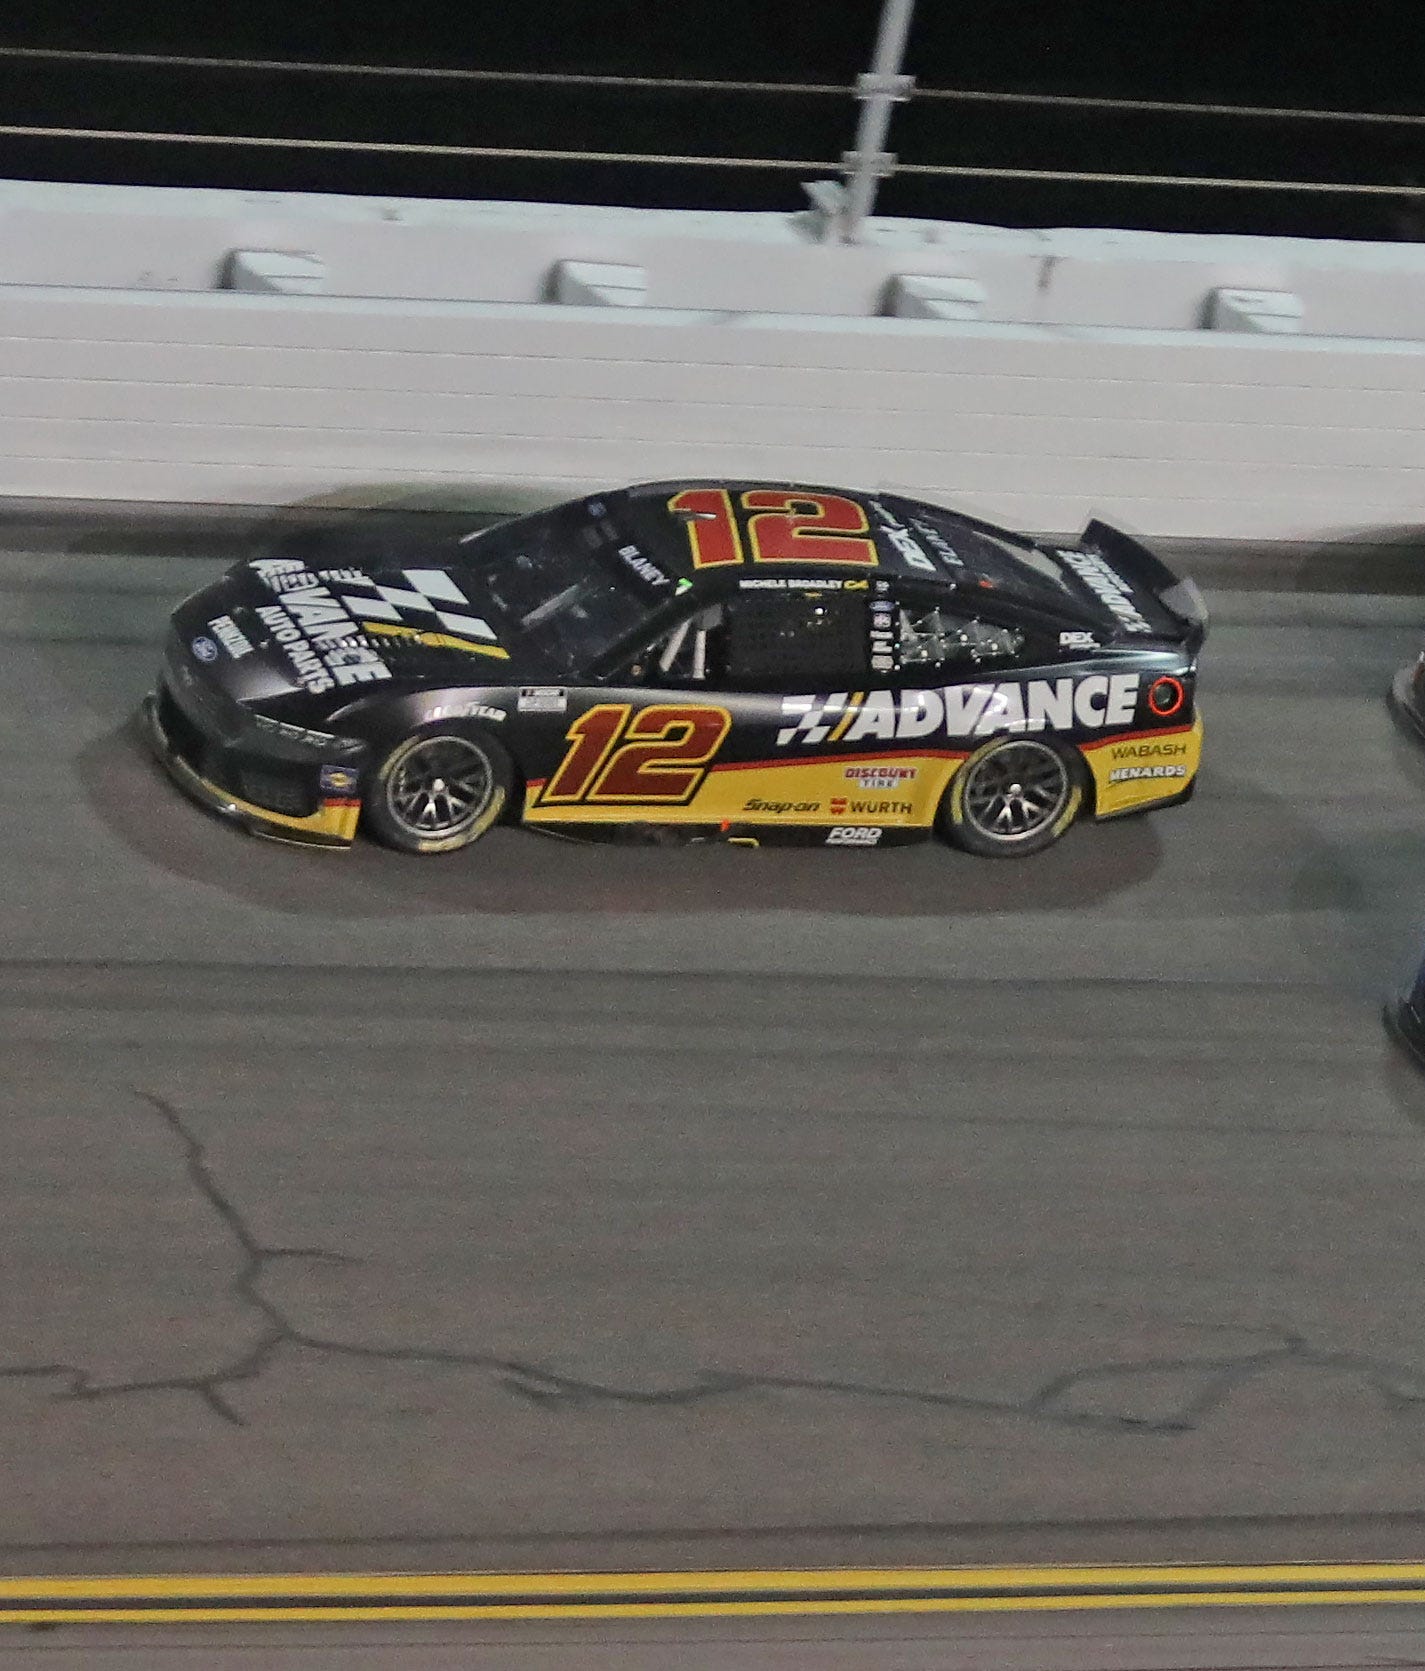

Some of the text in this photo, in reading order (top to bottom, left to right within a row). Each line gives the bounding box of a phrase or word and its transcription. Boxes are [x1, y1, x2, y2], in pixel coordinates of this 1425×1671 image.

[668, 489, 879, 569] 12
[618, 544, 670, 586] BLANEY
[249, 558, 393, 686] ADVANCE
[255, 605, 302, 642] AUTO
[283, 640, 335, 694] PARTS
[852, 674, 1141, 742] ADVANCE
[540, 703, 733, 805] 12
[1110, 765, 1186, 781] MENARDS
[1111, 743, 1186, 759] WABASH
[743, 799, 821, 814] Snap-on
[829, 827, 882, 840] FORD
